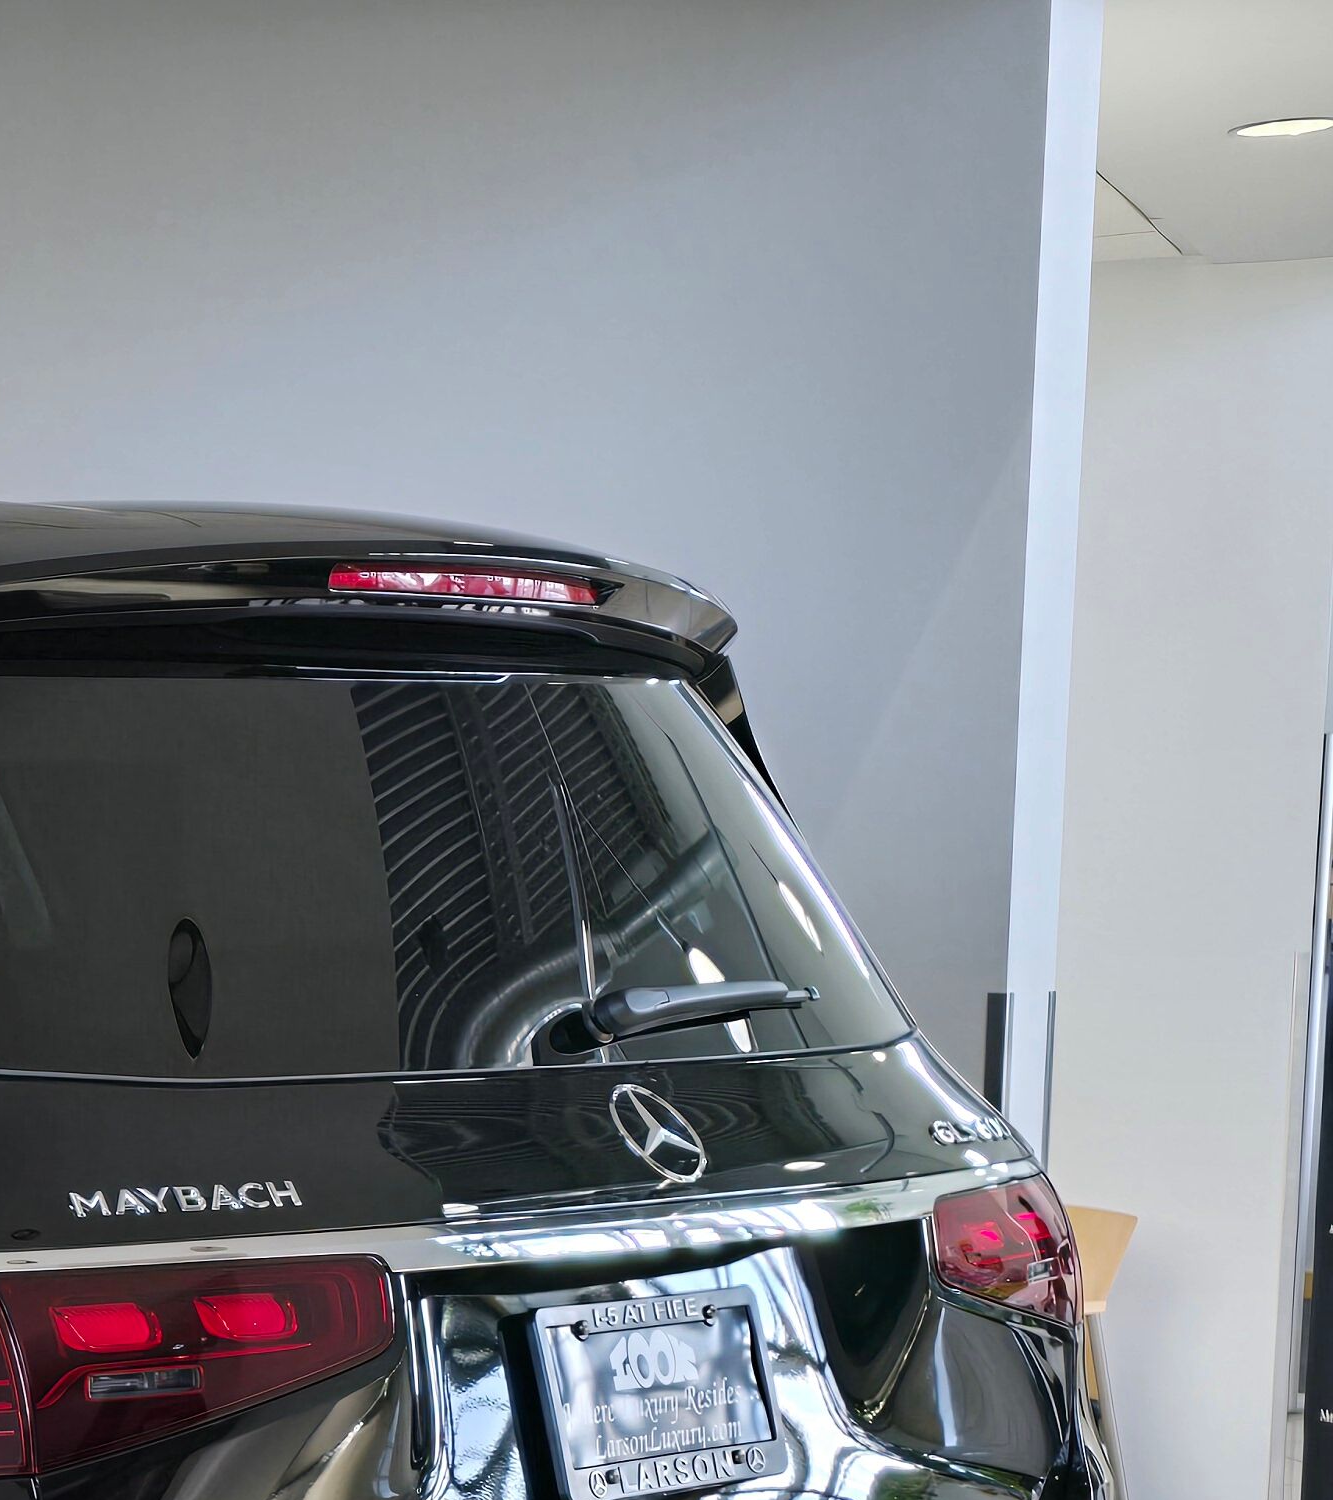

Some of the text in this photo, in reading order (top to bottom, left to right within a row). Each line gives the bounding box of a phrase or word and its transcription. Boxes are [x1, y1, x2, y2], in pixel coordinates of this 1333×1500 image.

[68, 1180, 303, 1218] MAYBACH
[592, 1297, 699, 1328] I-5 AT FIFE
[616, 1451, 735, 1494] LARSON
